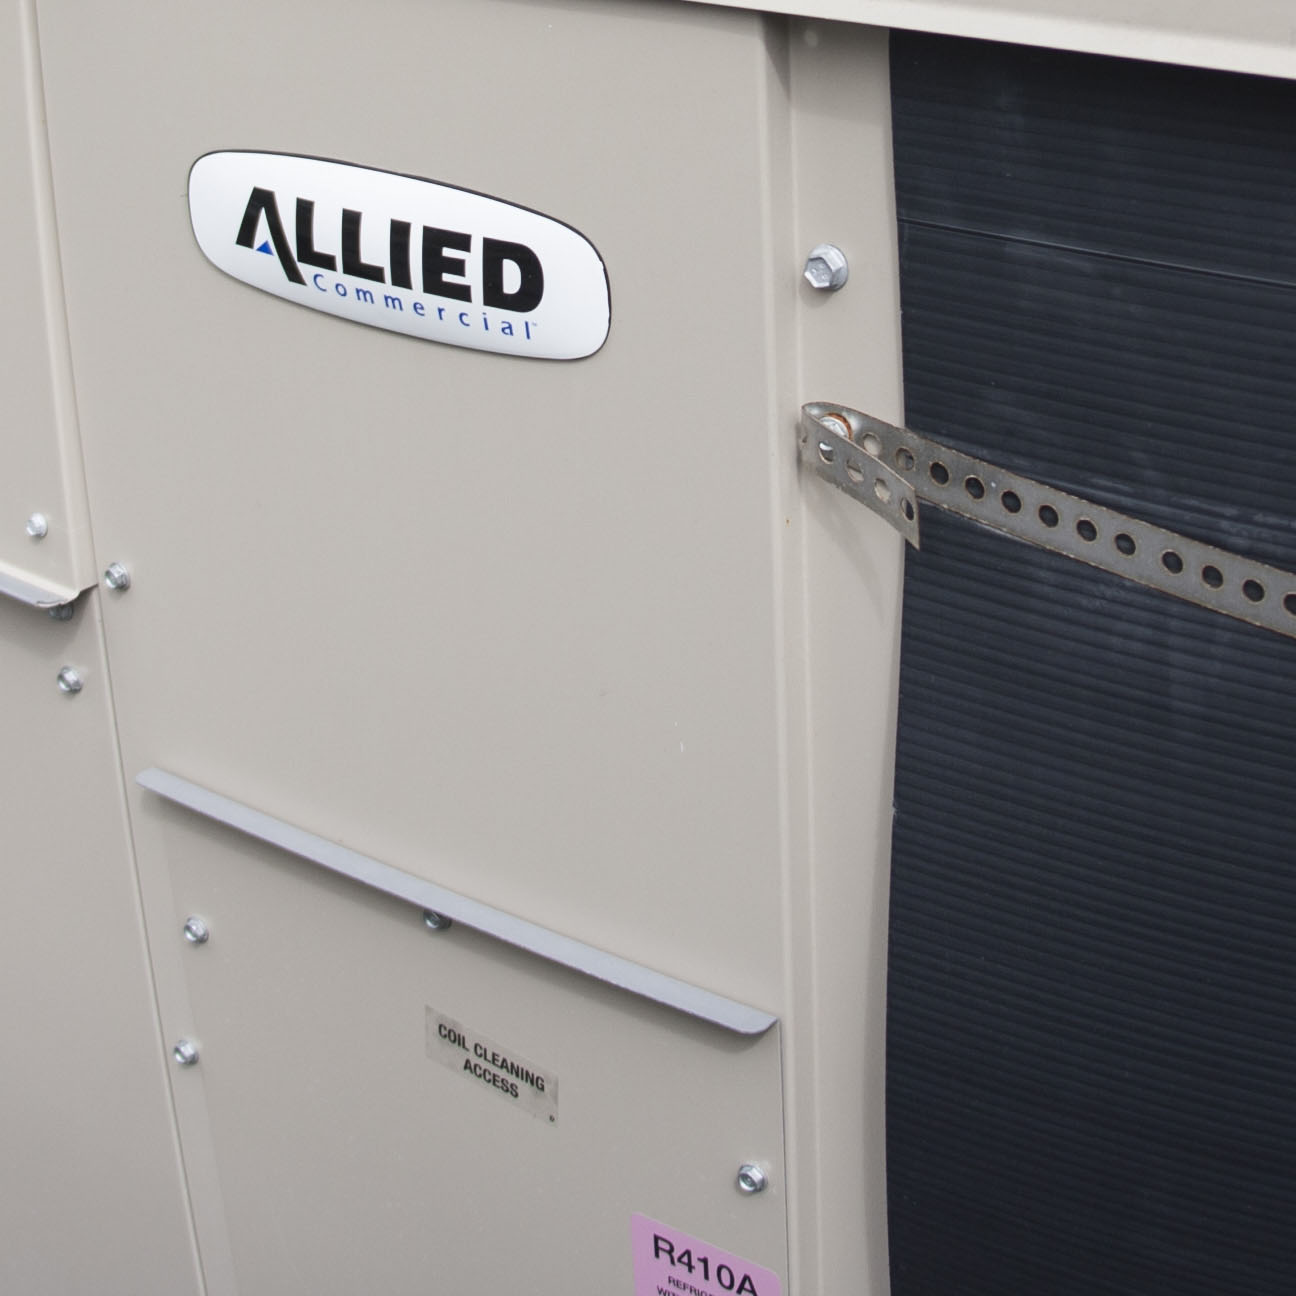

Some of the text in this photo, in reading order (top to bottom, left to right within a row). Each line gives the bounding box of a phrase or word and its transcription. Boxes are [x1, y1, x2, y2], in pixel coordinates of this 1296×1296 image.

[235, 186, 545, 314] ALLIED
[313, 273, 532, 340] Commercial
[438, 1023, 545, 1092] COIL CLEANING
[463, 1058, 519, 1099] ACCESS
[653, 1233, 759, 1296] R410A
